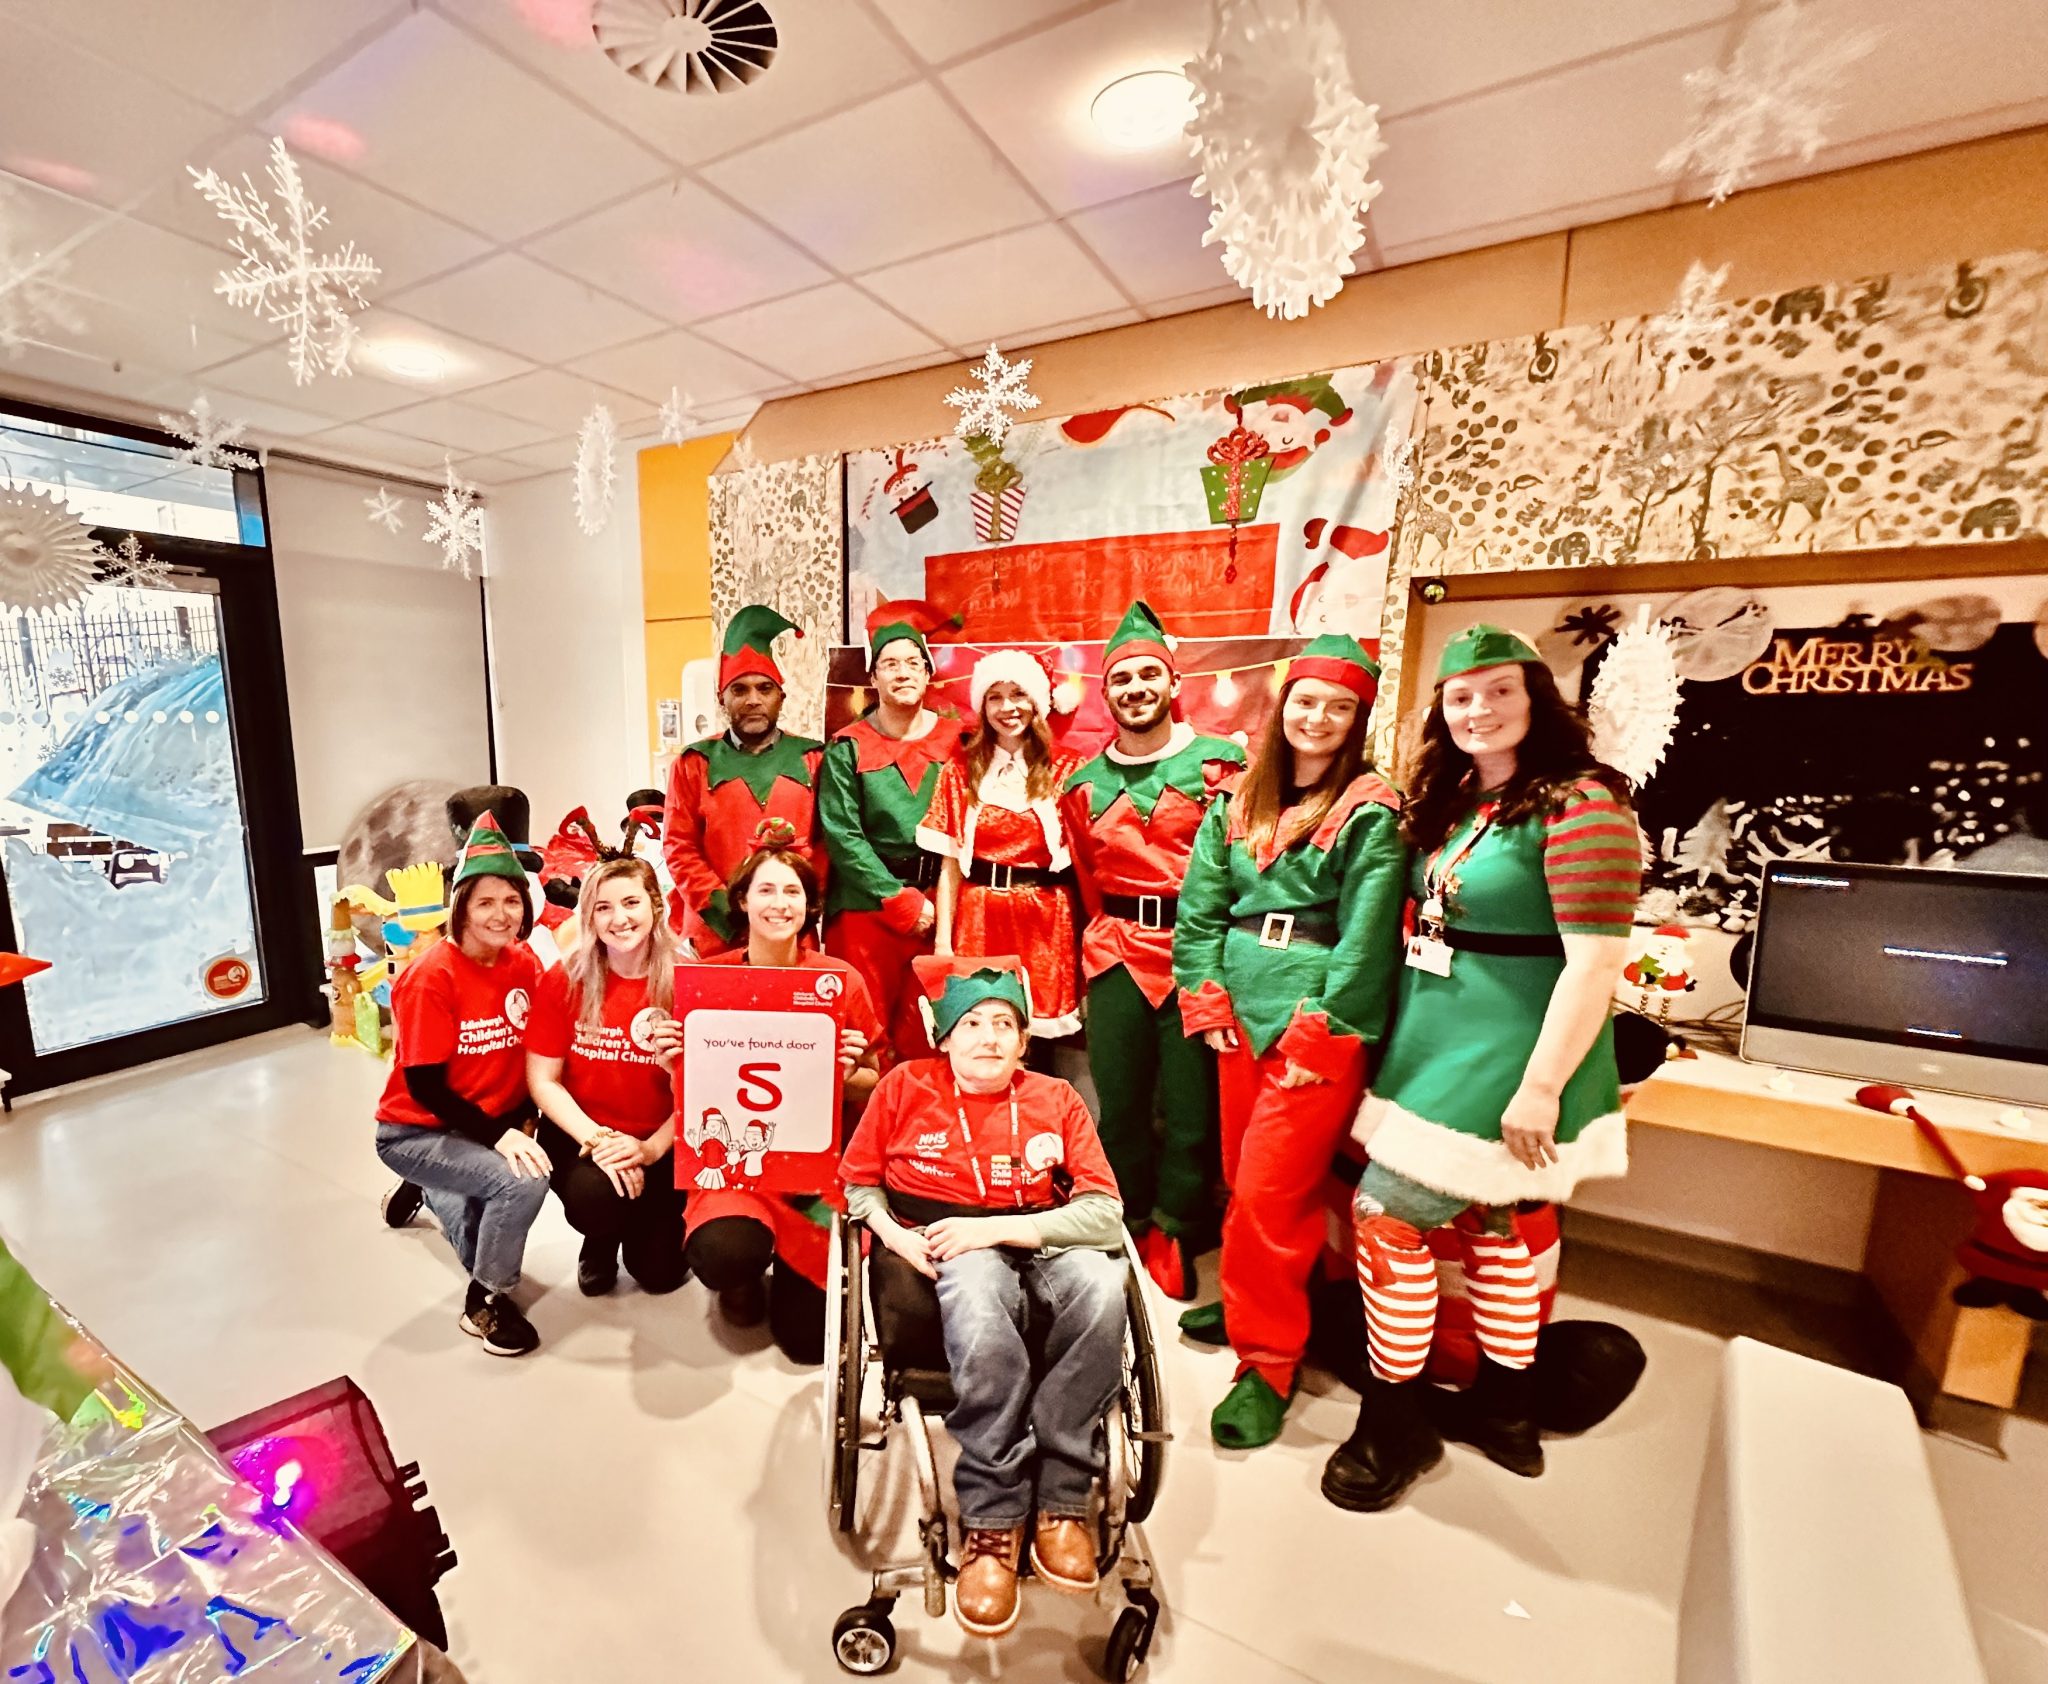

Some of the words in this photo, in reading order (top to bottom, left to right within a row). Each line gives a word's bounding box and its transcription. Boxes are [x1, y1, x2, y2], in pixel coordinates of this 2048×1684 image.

[1773, 637, 1913, 670] MERRY
[1742, 662, 1973, 695] CHRISTMAS
[461, 1015, 504, 1031] Edinburgh
[459, 1025, 513, 1043] Children's
[457, 1037, 506, 1055] Hospital
[748, 1037, 783, 1051] found
[786, 1040, 817, 1050] door
[918, 1132, 948, 1145] NHS
